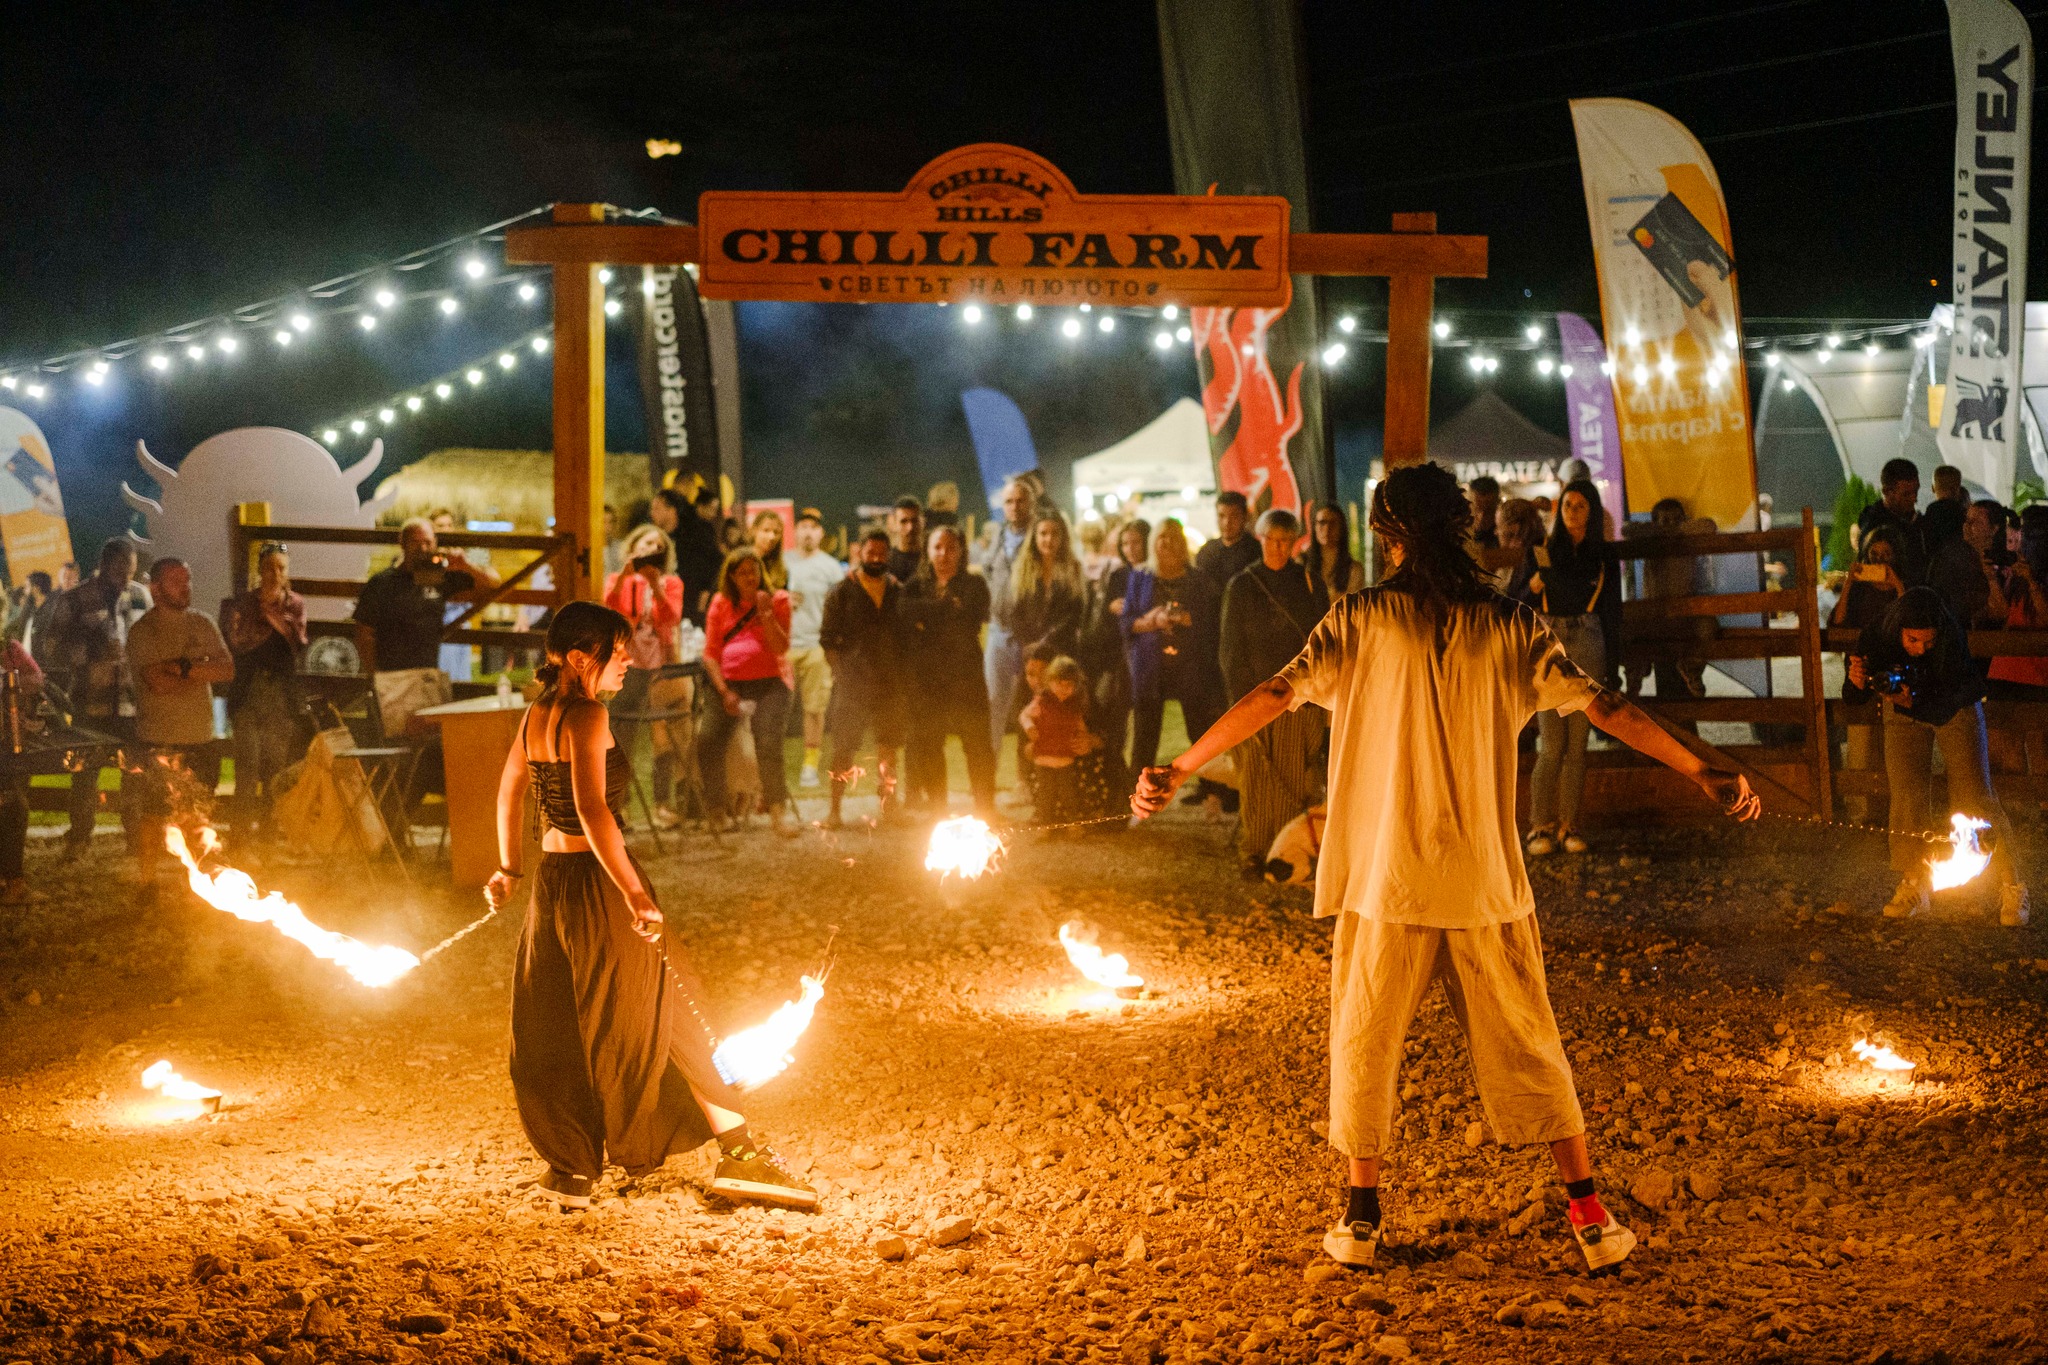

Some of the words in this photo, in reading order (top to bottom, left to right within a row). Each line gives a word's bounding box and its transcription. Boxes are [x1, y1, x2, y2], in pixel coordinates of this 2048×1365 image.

[928, 167, 1053, 200] CHILLI
[937, 207, 1042, 222] HILLS
[721, 229, 999, 266] CHILLI
[1024, 233, 1264, 270] FARM
[838, 275, 952, 294] СВЕТЪТ
[969, 277, 1007, 296] НА
[1019, 278, 1140, 297] ЛЮТОТО
